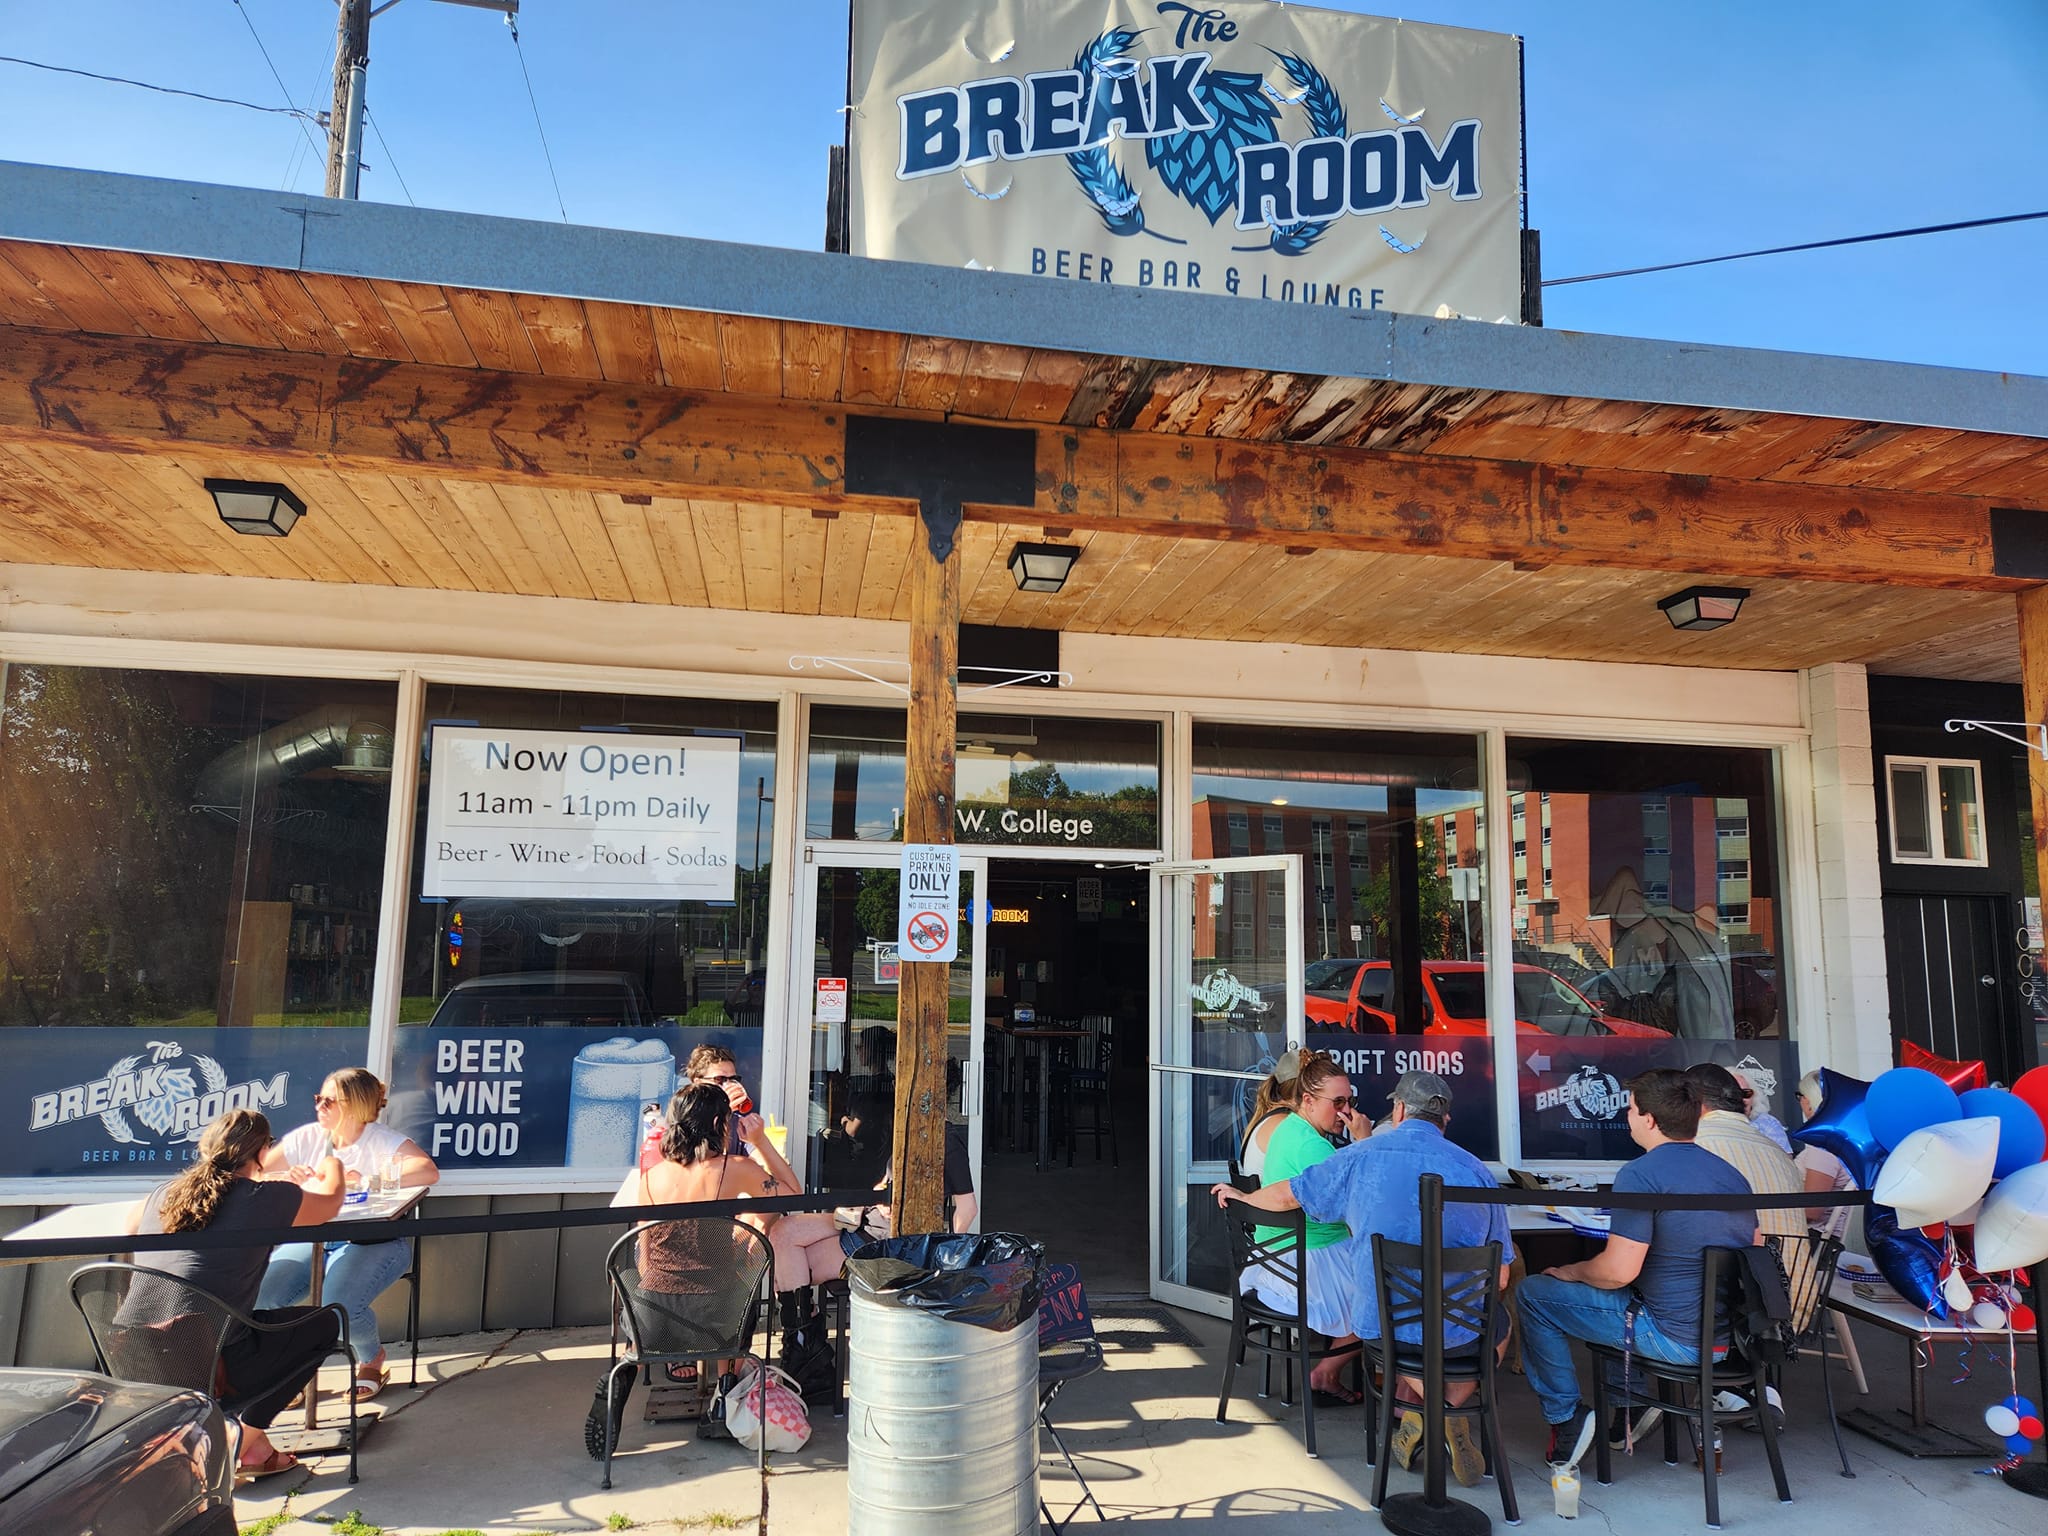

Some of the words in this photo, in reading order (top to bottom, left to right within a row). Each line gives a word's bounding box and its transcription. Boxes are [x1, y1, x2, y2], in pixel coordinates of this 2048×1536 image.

[1157, 1, 1239, 49] The
[896, 51, 1215, 180] BREAK
[1234, 119, 1482, 231] ROOM
[1032, 247, 1113, 283] BEER
[1139, 259, 1201, 288] BAR
[1225, 267, 1241, 295] &
[1262, 274, 1384, 309] LOUNGE
[485, 741, 567, 772] Now
[580, 745, 686, 780] Open!
[458, 791, 533, 814] 11am
[562, 794, 636, 821] 11pm
[647, 797, 711, 824] Daily
[956, 808, 990, 832] W.
[1000, 808, 1093, 840] College
[438, 842, 488, 863] Beer
[510, 843, 571, 864] Wine
[593, 844, 647, 866] Food
[666, 846, 728, 868] Sodas
[909, 852, 952, 862] CUSTOMER
[909, 861, 952, 873] PARKING
[909, 872, 951, 891] ONLY
[1079, 888, 1100, 899] HERE
[918, 902, 932, 910] IDLE
[934, 902, 951, 910] ZONE
[992, 908, 1029, 922] ROOM
[146, 1041, 183, 1064] The
[436, 1039, 525, 1074] BEER
[1315, 1049, 1386, 1075] RAFT
[1395, 1050, 1465, 1076] SODAS
[1581, 1065, 1598, 1077] The
[29, 1062, 169, 1132] BREAK
[171, 1072, 289, 1135] ROOM
[435, 1080, 521, 1115] WINE
[1535, 1078, 1592, 1111] BREAK
[1600, 1090, 1630, 1114] ROO
[432, 1122, 520, 1157] FOOD
[82, 1150, 120, 1162] BEER
[129, 1150, 156, 1162] BAR
[164, 1150, 173, 1161] &
